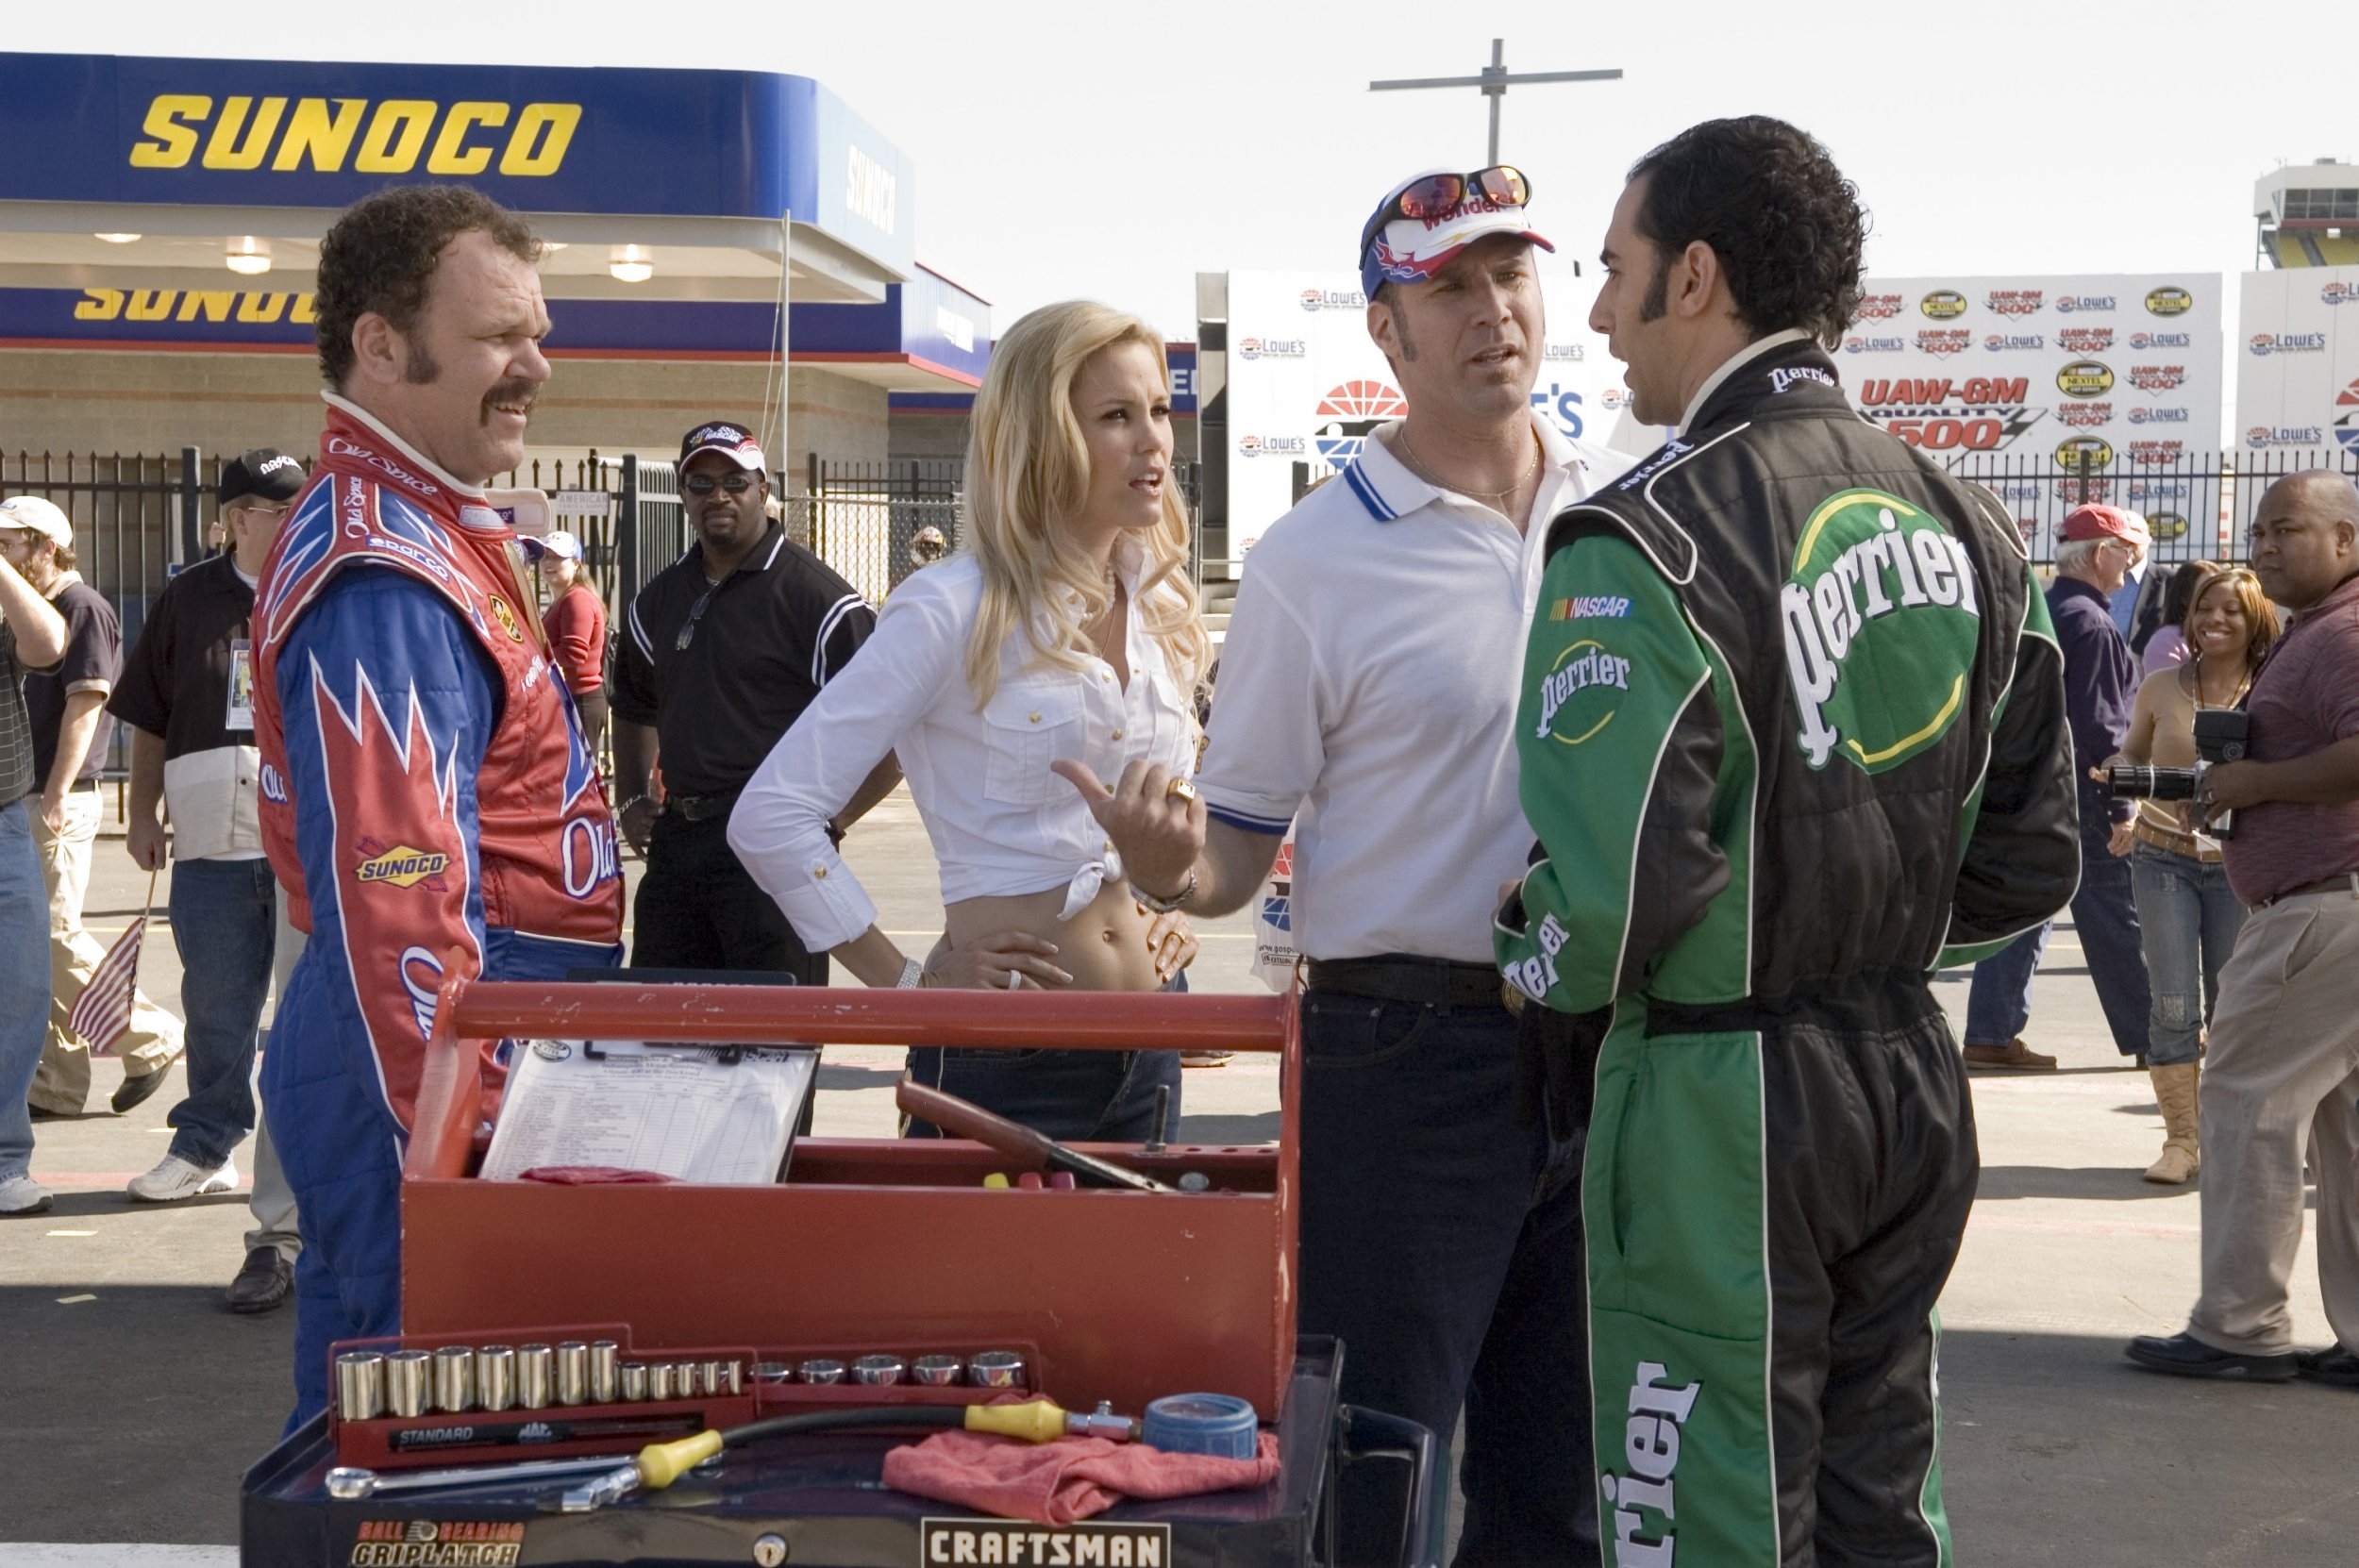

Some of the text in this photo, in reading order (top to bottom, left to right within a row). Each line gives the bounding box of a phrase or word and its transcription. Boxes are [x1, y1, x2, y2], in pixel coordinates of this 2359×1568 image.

[129, 94, 582, 176] SUNOCO
[1263, 338, 1305, 353] LOWE'S
[2276, 332, 2325, 347] LOWE'S
[1860, 377, 2029, 406] UAW-GM
[1871, 409, 2016, 418] QUALITY
[1263, 436, 1305, 450] LOWE'S
[1887, 419, 2003, 450] 500
[2272, 426, 2322, 441] LOWE'S
[328, 438, 438, 495] Old Spice
[1571, 596, 1630, 618] NASCAR
[362, 856, 443, 878] SUNOCO
[399, 1426, 473, 1443] STANDARD
[358, 1521, 526, 1542] BALL BEARING
[351, 1542, 521, 1568] GRIPLATCH
[930, 1530, 1161, 1567] CRAFTSMAN
